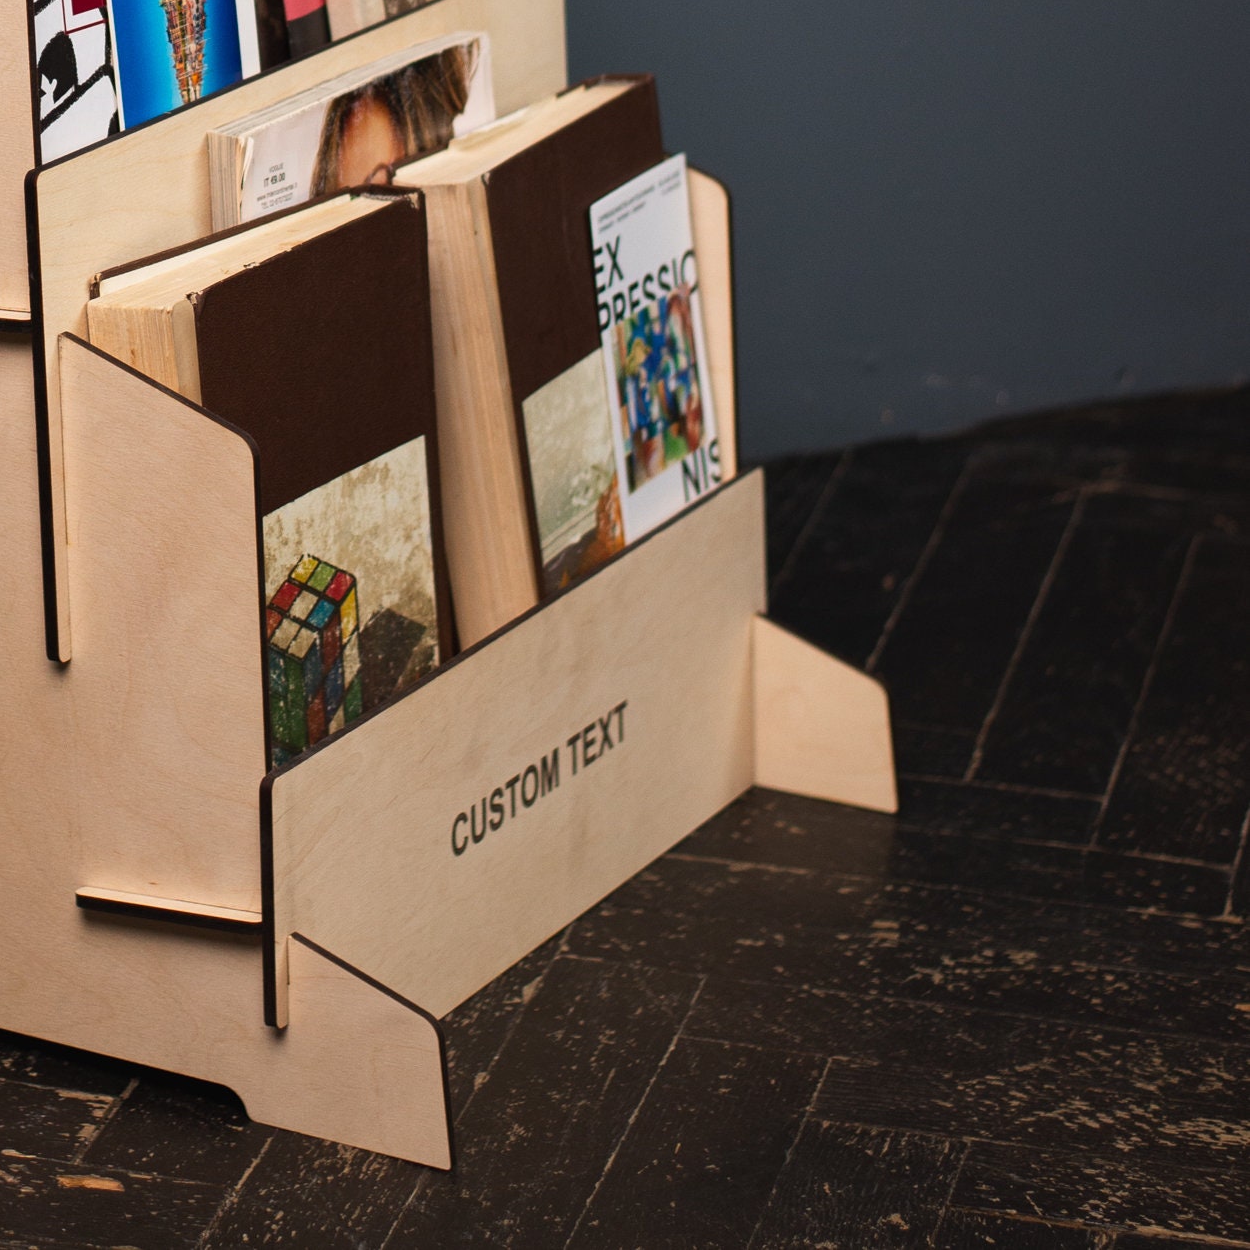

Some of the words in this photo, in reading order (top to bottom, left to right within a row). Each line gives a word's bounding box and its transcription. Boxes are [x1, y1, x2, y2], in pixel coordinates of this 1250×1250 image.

[594, 235, 624, 294] EX
[451, 747, 560, 857] CUSTOM
[566, 699, 628, 777] TEXT
